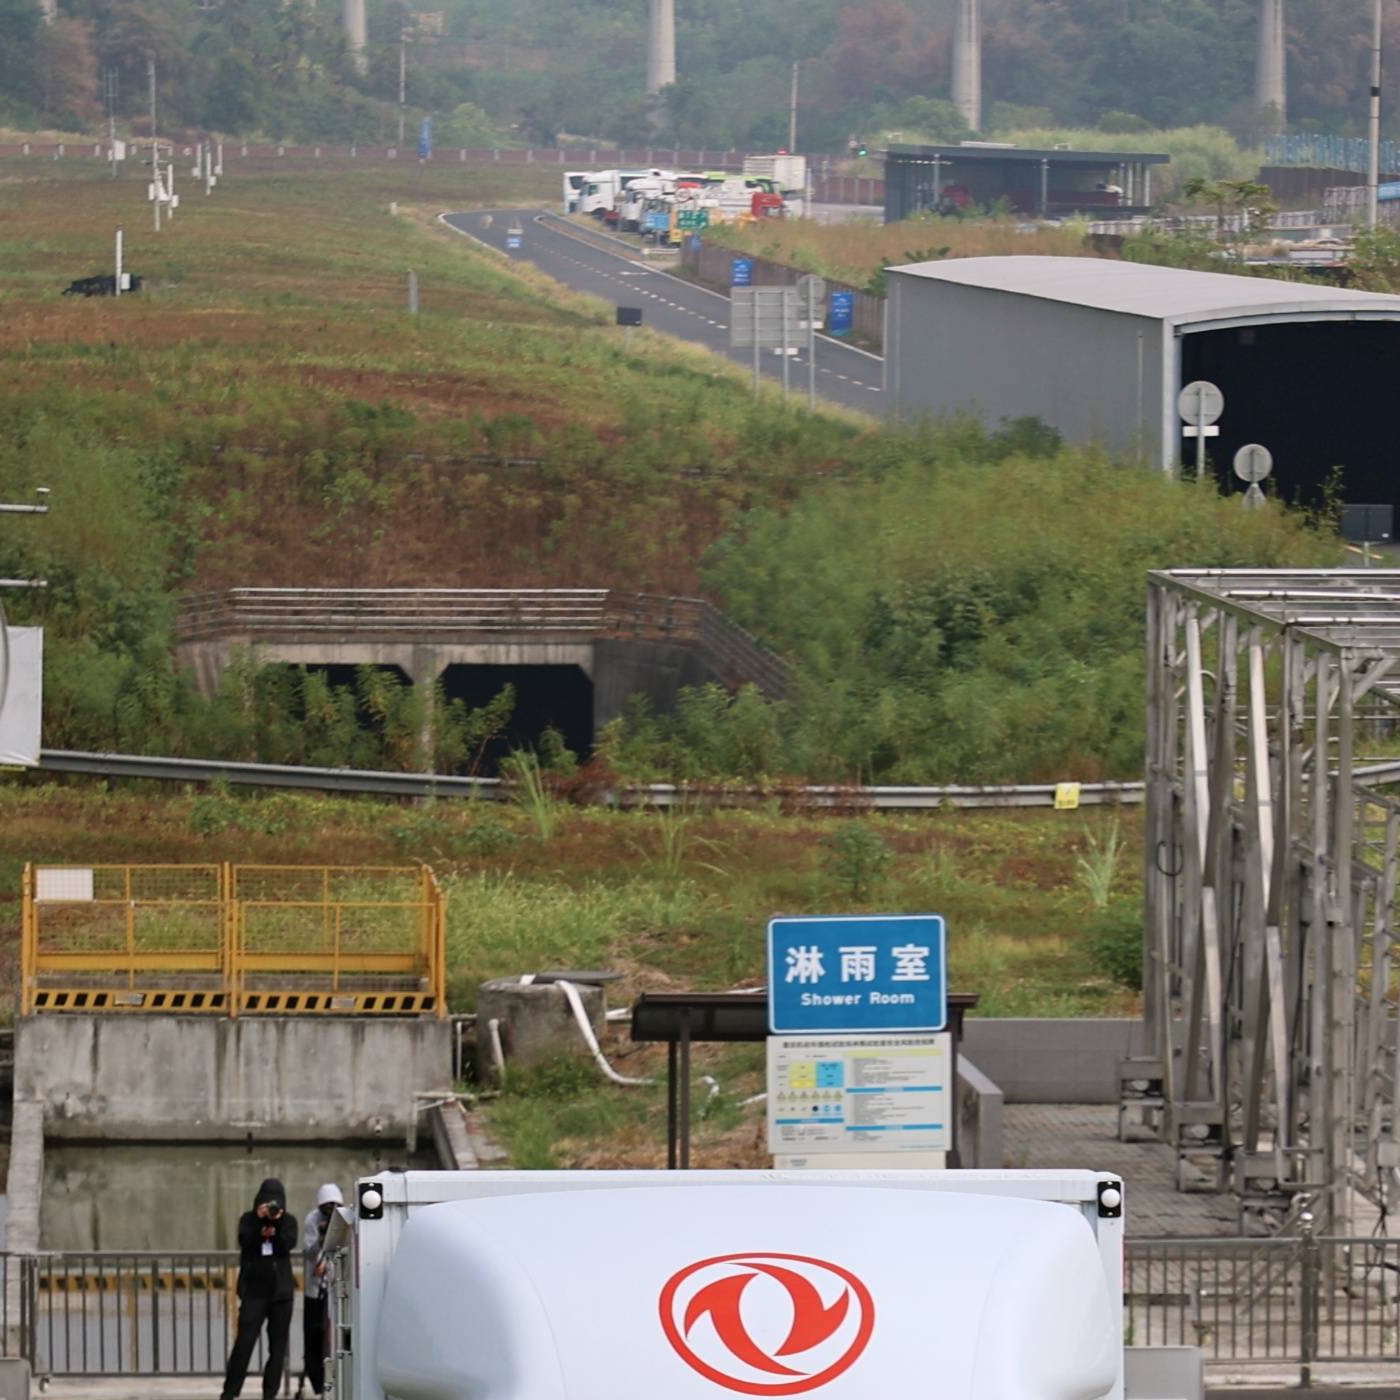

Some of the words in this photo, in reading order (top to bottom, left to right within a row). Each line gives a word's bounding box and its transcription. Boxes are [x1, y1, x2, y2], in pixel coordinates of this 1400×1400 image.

[785, 943, 930, 984] 淋雨室
[801, 992, 861, 1006] Shower
[869, 991, 915, 1005] Room
